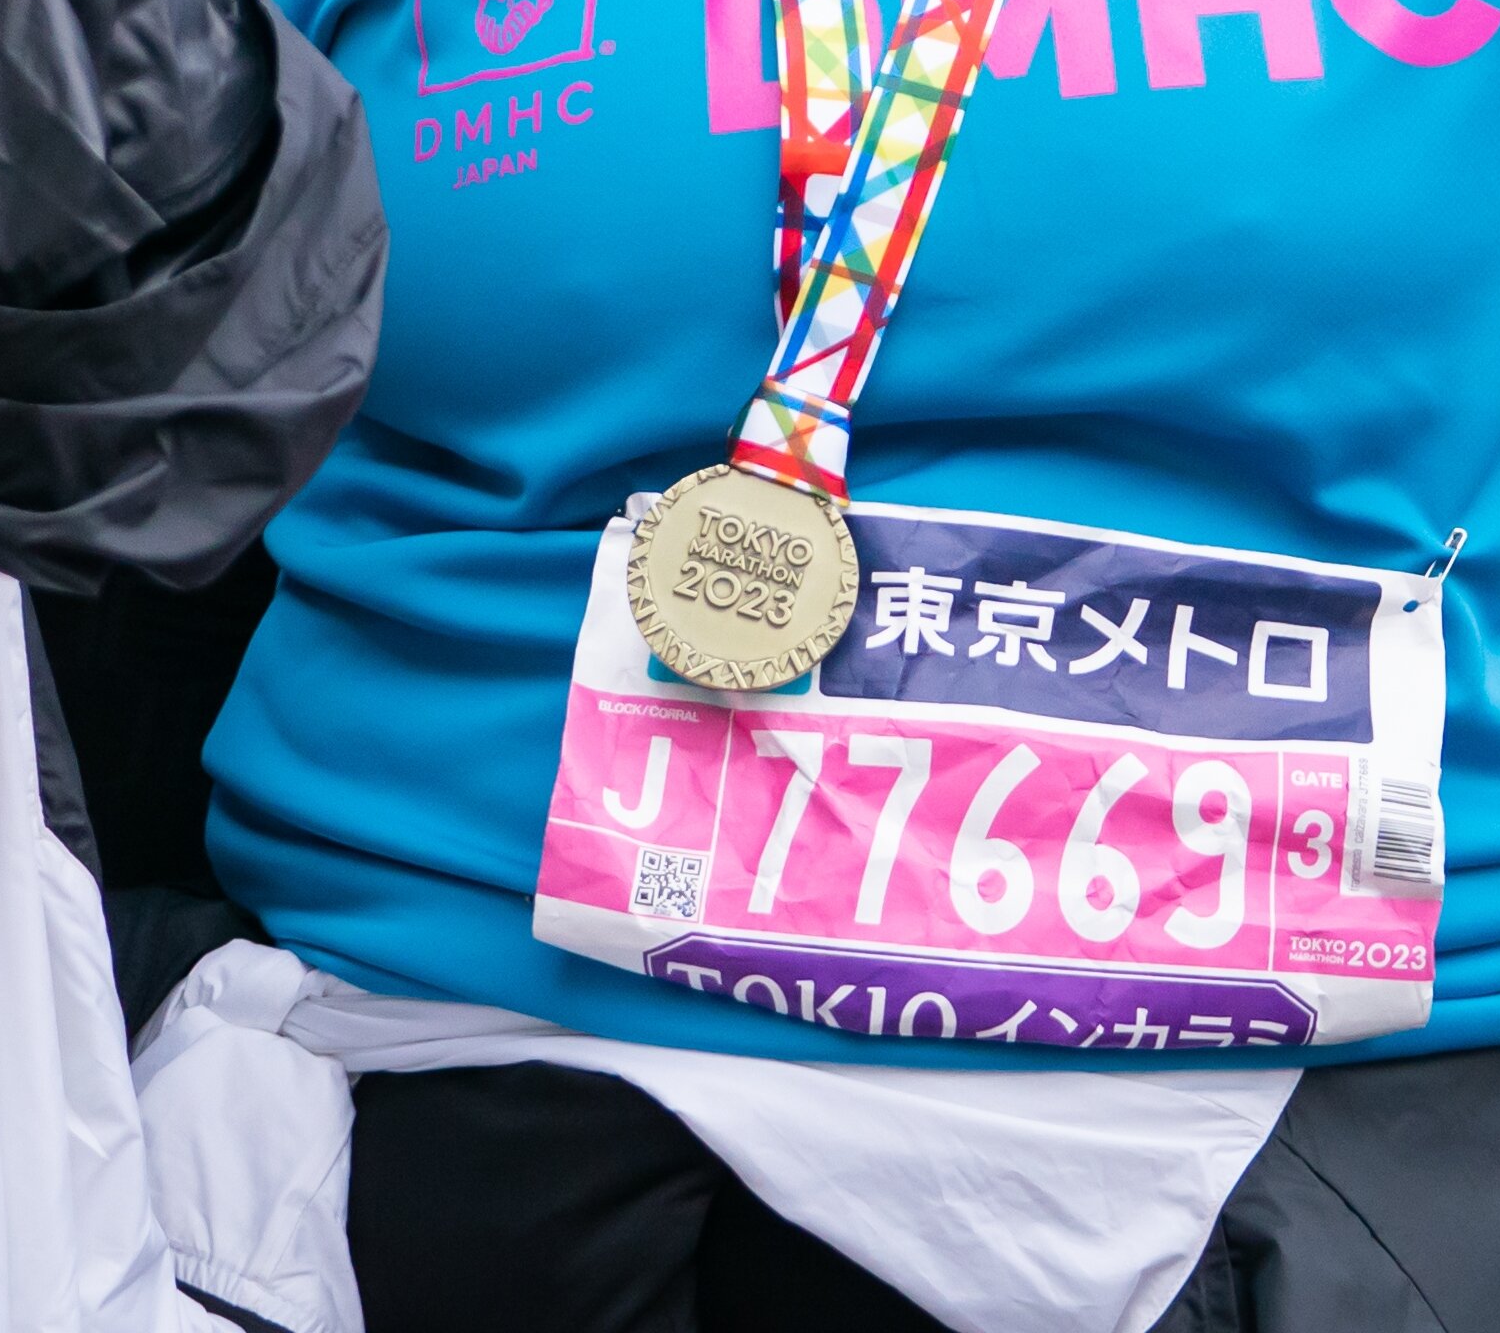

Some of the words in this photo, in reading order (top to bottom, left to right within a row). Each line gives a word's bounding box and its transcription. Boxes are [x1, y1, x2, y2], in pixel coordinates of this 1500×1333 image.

[414, 79, 595, 163] DMHC
[451, 146, 540, 191] JAPAN
[688, 539, 804, 589] MARATHON
[699, 508, 814, 566] TOKYO
[673, 560, 796, 626] 2023
[866, 566, 1328, 703] 東京メトロ
[598, 699, 700, 722] BLOCK/CORRAL
[602, 735, 672, 829] J
[1290, 770, 1343, 788] GATE
[748, 731, 1253, 950] 77669
[1287, 809, 1335, 879] 3
[1288, 953, 1345, 965] MARATHON
[1289, 937, 1346, 953] TOKYO
[1347, 941, 1427, 970] 2023
